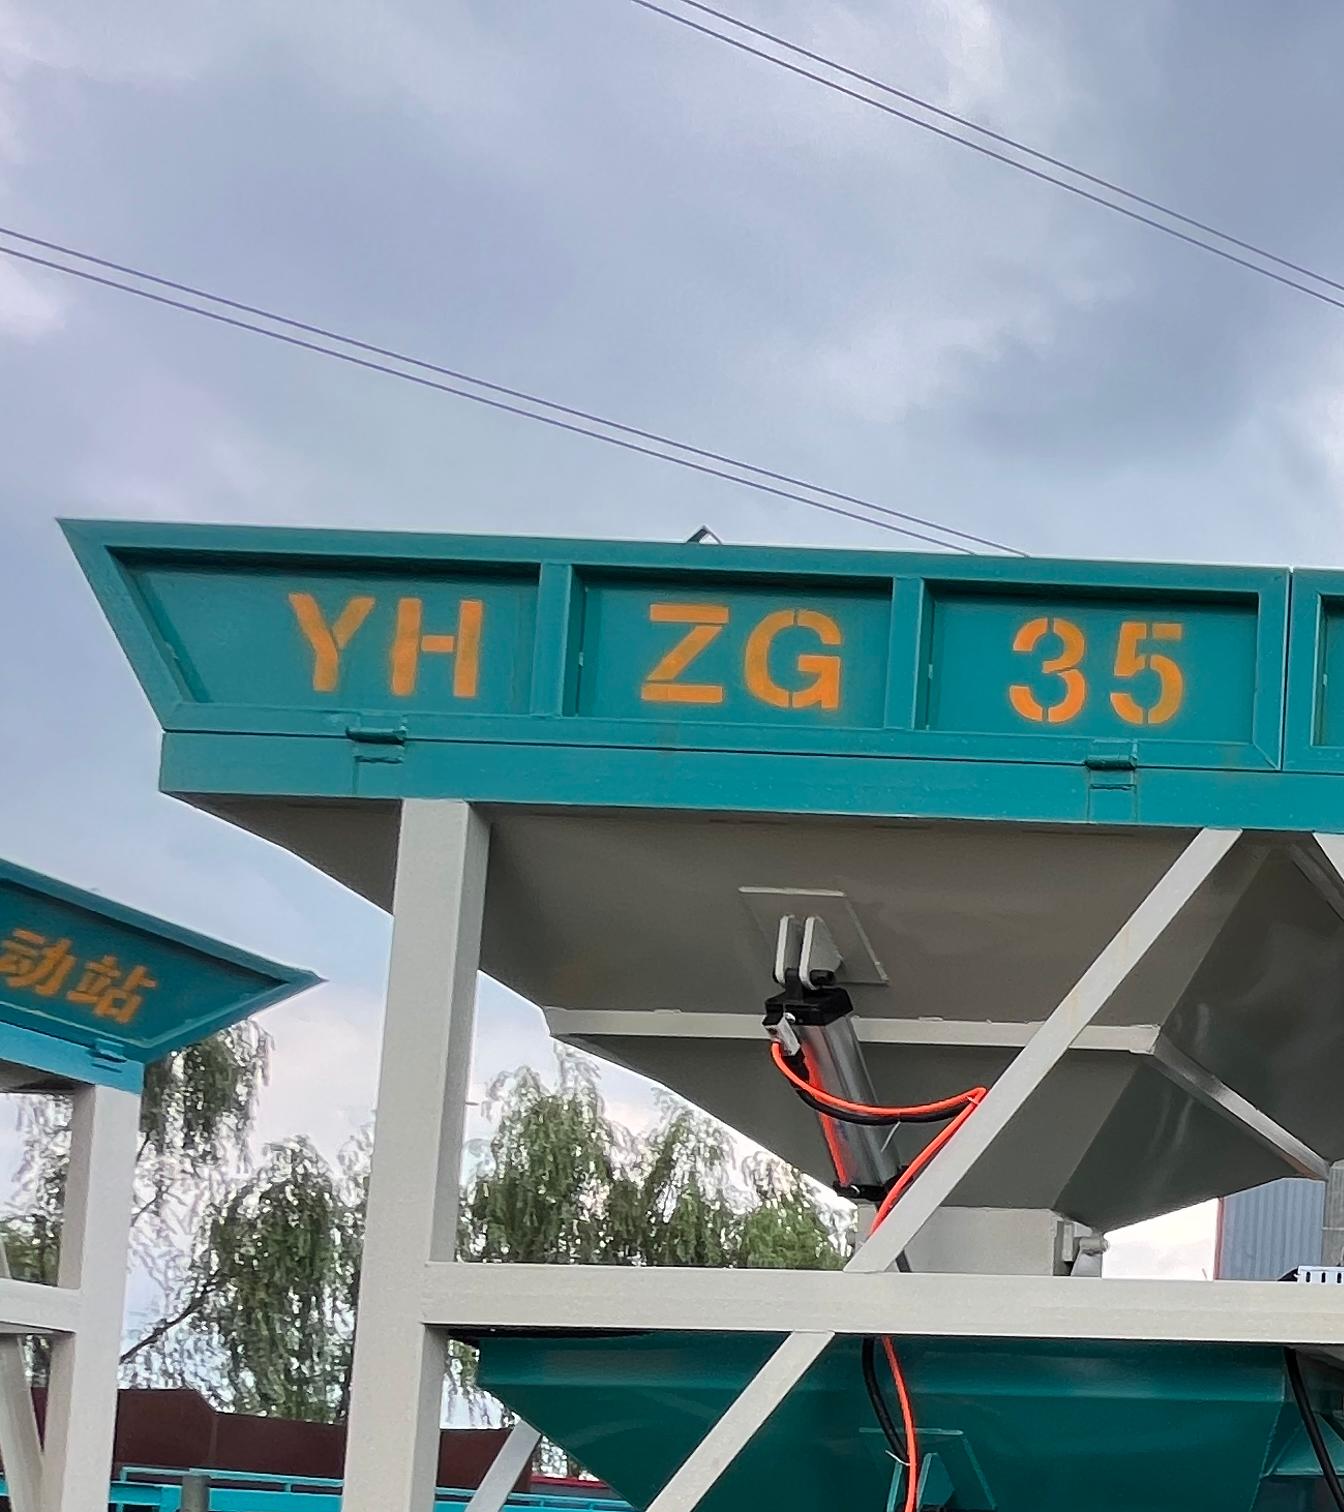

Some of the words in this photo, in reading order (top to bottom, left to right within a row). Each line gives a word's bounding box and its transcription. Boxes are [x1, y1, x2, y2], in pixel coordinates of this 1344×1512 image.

[289, 593, 483, 698] YH
[640, 603, 841, 710] ZG
[1008, 617, 1185, 724] 35
[0, 928, 157, 1024] 动站
